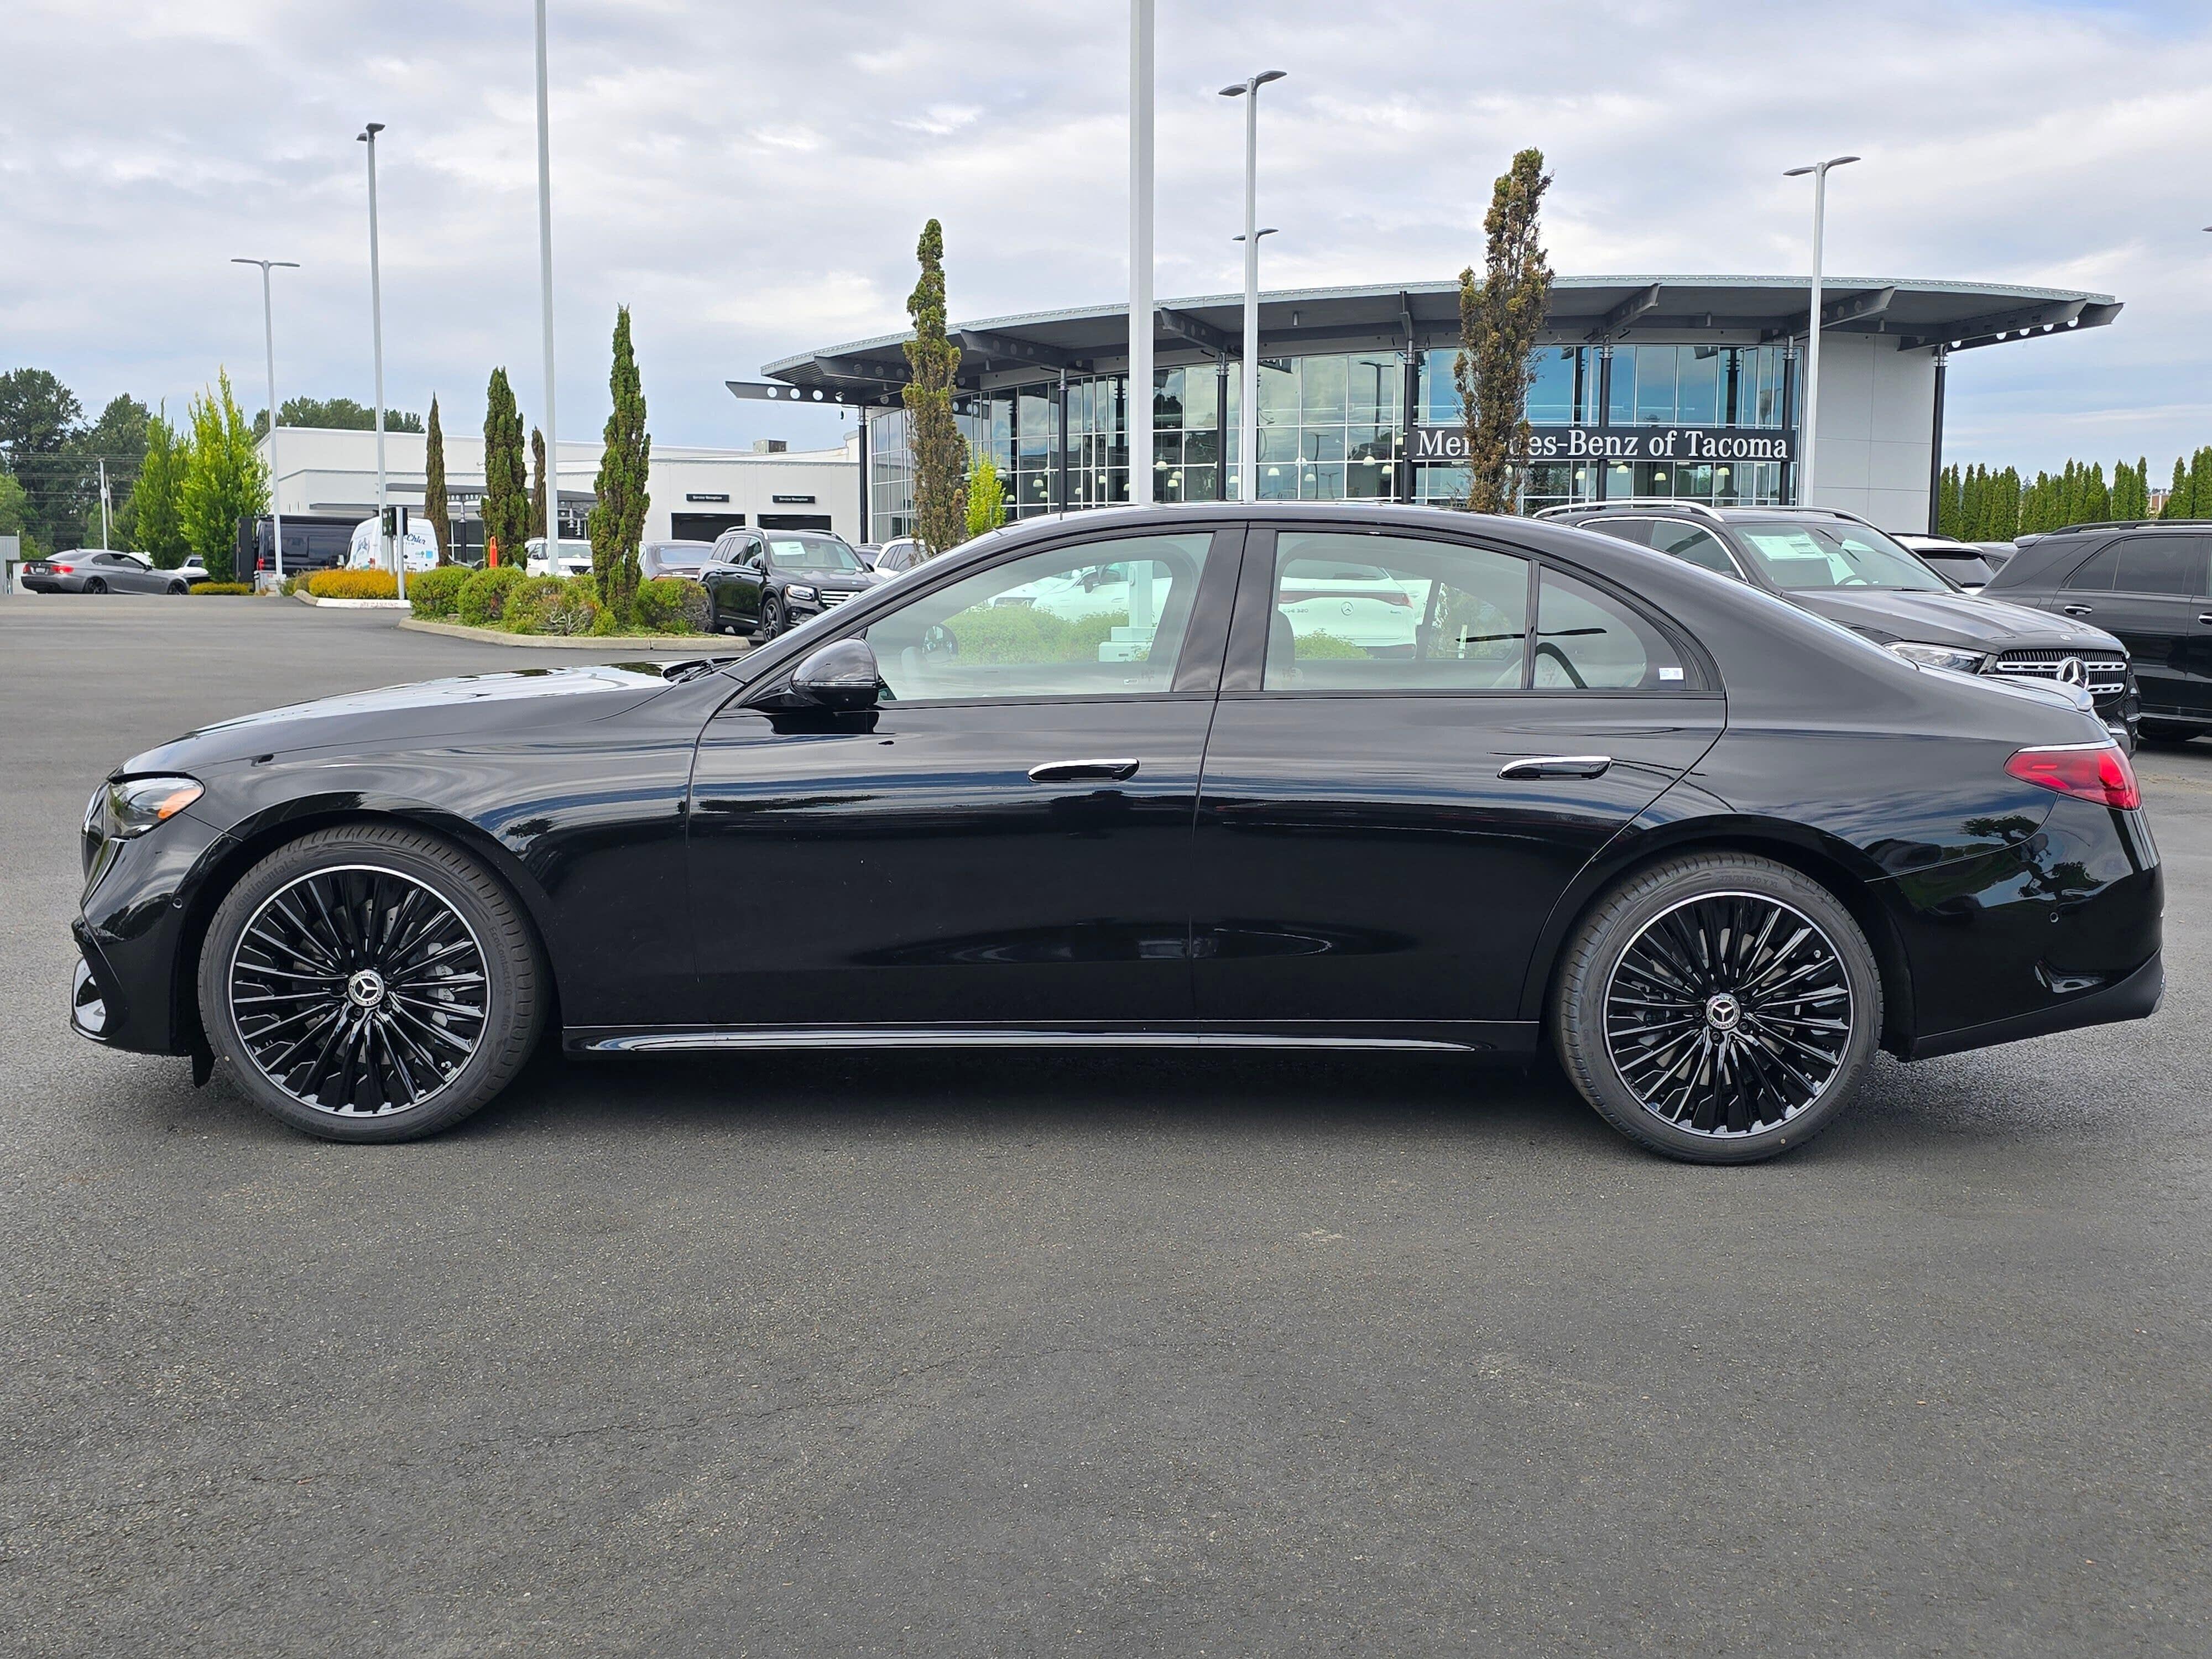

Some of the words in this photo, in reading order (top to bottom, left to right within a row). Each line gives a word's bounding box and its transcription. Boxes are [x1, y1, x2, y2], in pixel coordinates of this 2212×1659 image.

[1416, 430, 1639, 456] Meres-Benz
[1648, 430, 1677, 456] of
[1684, 430, 1788, 458] Tacoma
[234, 860, 290, 911] Continental
